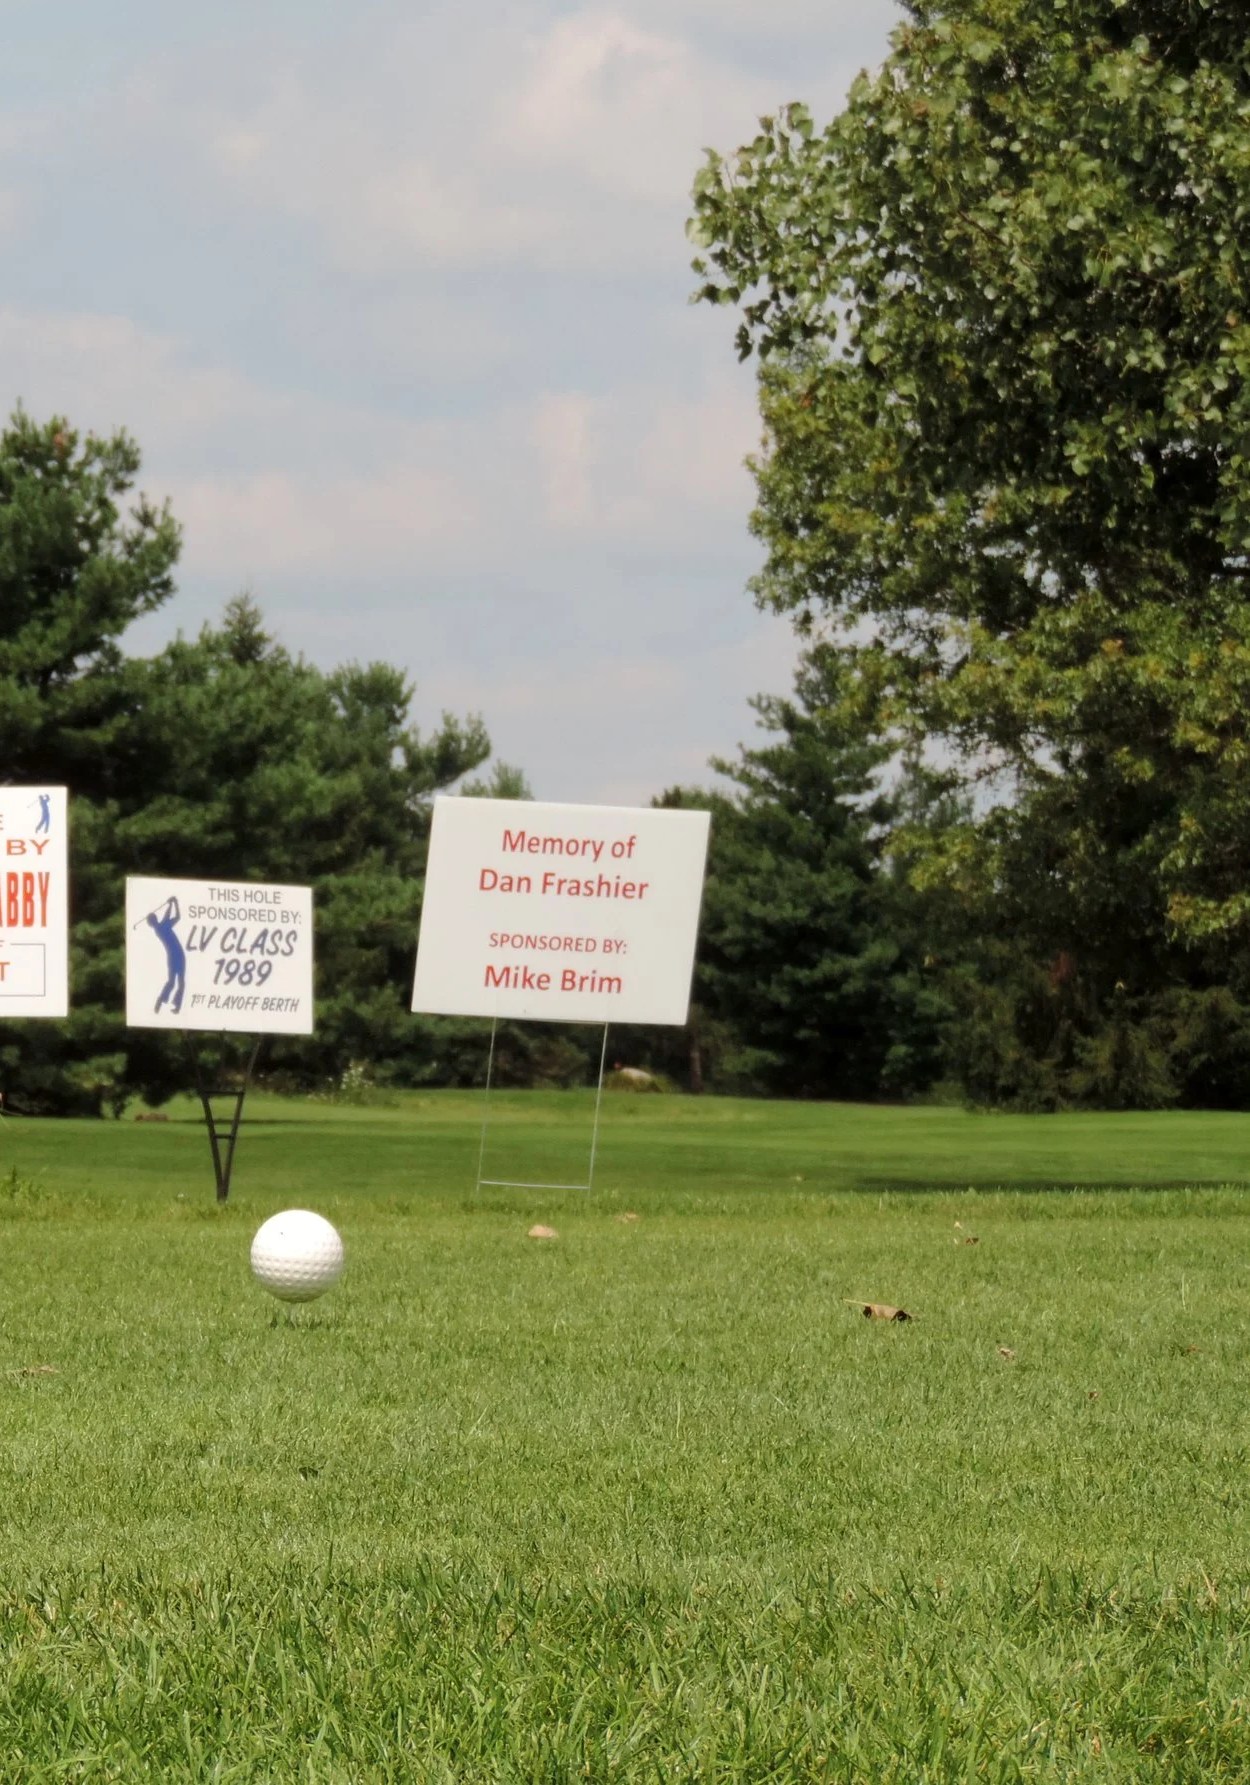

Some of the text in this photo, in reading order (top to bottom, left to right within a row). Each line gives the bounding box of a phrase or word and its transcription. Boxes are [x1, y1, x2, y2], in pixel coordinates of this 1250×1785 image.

[5, 838, 51, 856] BY
[502, 829, 637, 862] Memory of
[207, 887, 282, 904] THIS HOLE
[479, 868, 650, 900] Dan Frashier
[188, 905, 302, 925] SPONSORED BY:
[185, 924, 298, 957] LV CLASS
[489, 932, 628, 954] SPONSORED BY:
[213, 957, 273, 987] 1989
[483, 965, 623, 994] Mike Brim
[207, 994, 261, 1011] PLAYOFF
[261, 996, 300, 1013] BERTH
